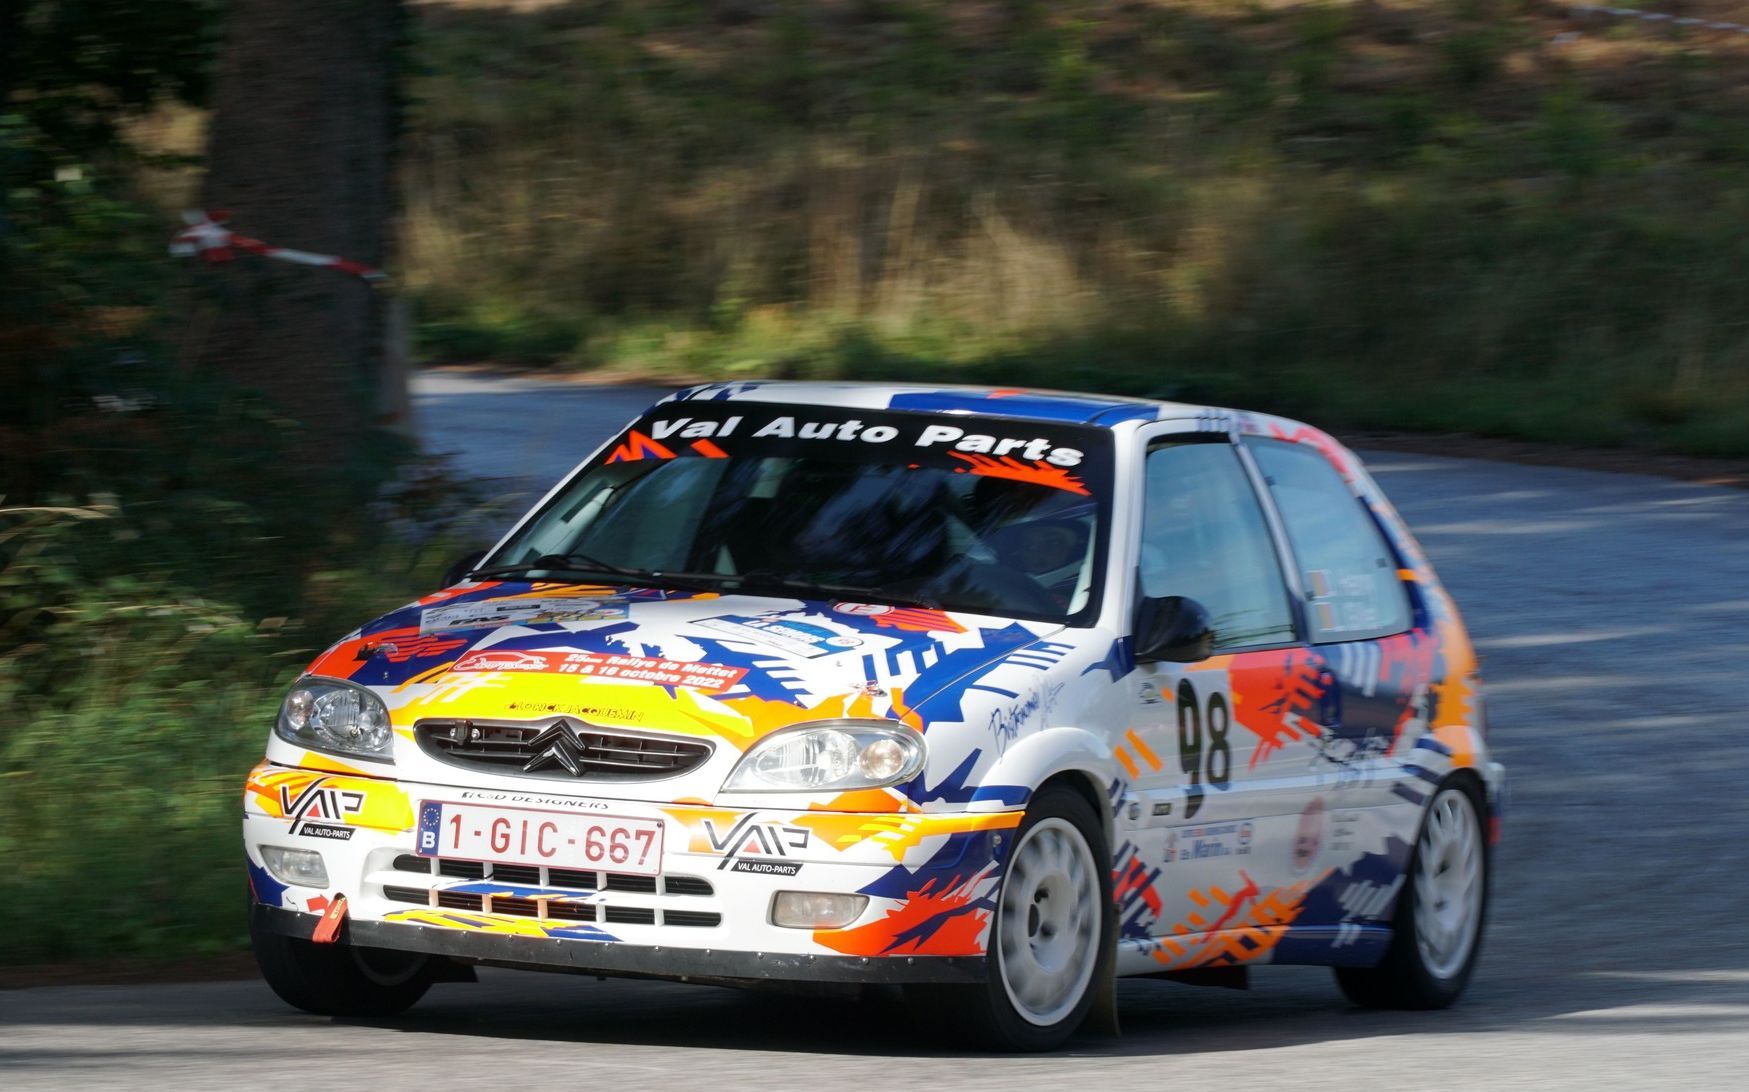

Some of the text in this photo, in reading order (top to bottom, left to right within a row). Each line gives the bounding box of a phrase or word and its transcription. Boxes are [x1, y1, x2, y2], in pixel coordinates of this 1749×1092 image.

[651, 416, 1085, 467] Val Auto Parts
[558, 664, 725, 689] 15 & 16 octobre 2022
[606, 656, 656, 669] Rallye
[658, 662, 680, 671] de
[681, 664, 738, 679] Mettet
[1177, 678, 1232, 819] 98
[304, 827, 351, 839] VAL AUTO-PARTS
[422, 831, 436, 848] B
[450, 814, 656, 865] 1-GIC-667
[737, 862, 797, 875] VAL AUTO-PARTS
